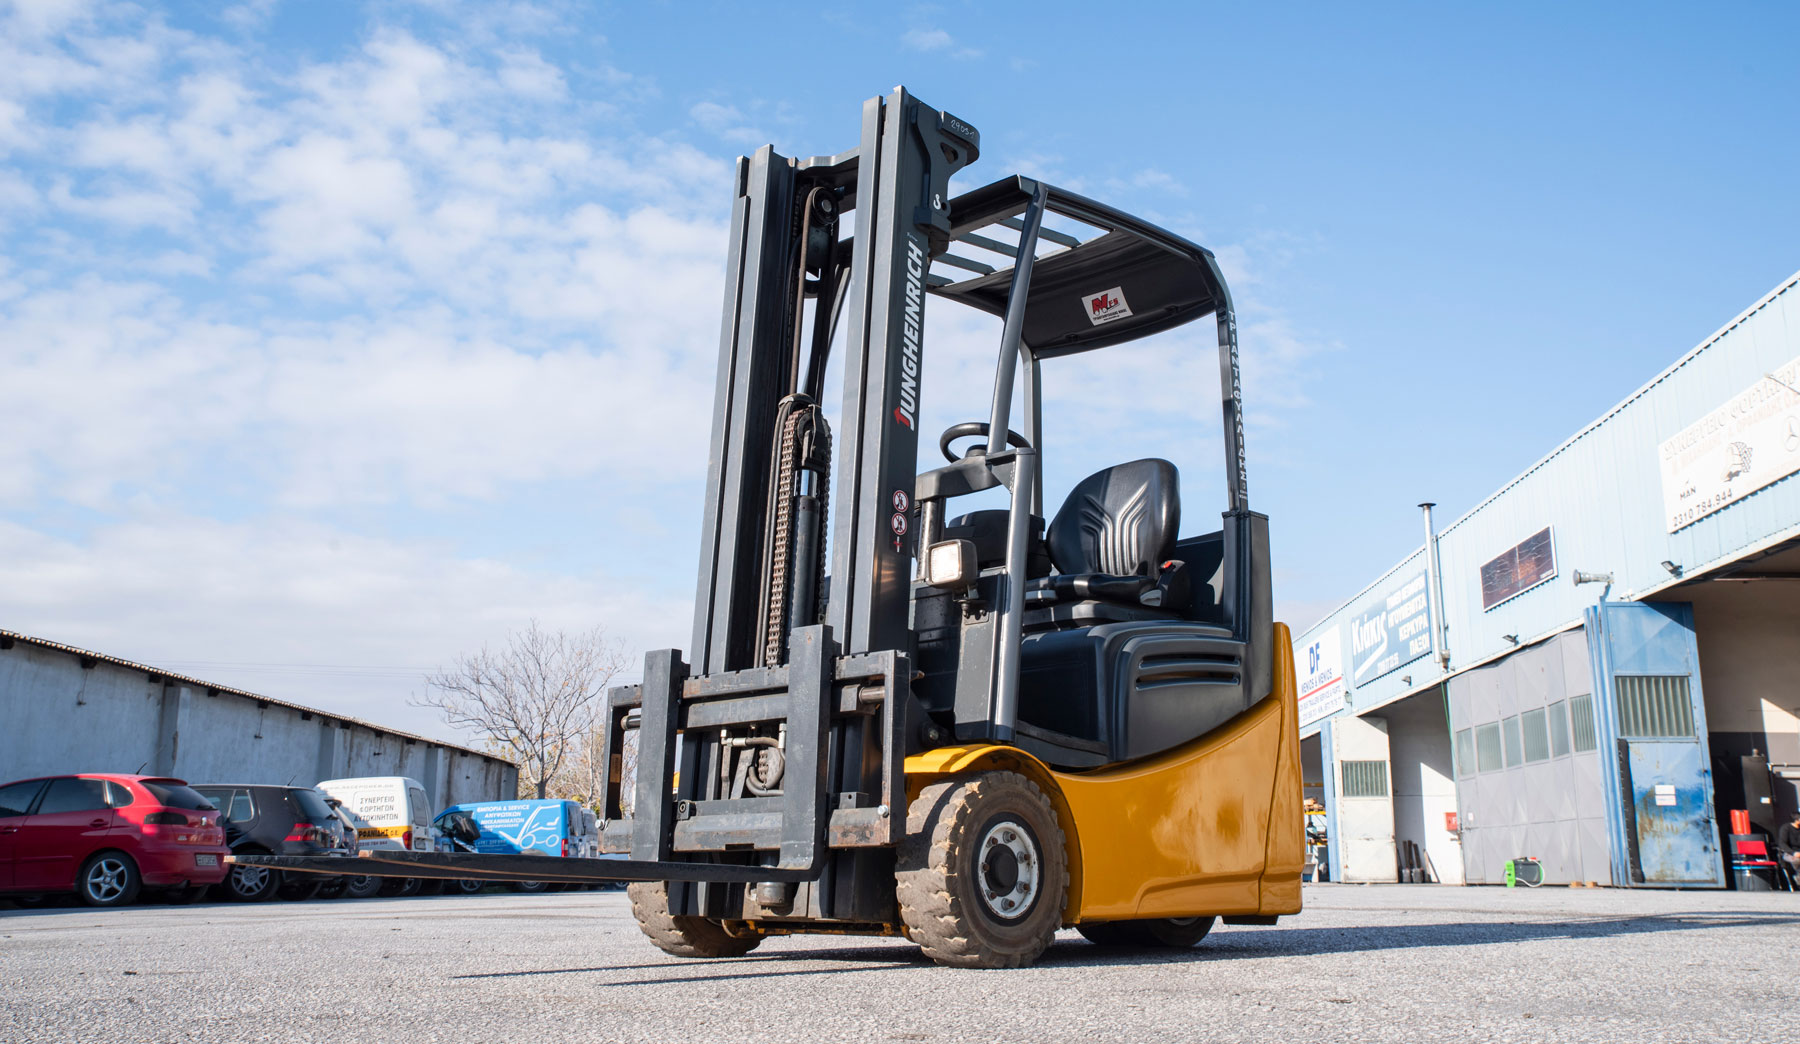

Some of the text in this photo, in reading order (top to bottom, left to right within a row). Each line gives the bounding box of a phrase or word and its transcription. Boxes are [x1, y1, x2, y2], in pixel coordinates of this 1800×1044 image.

[895, 241, 922, 431] JUNGHEINRICH
[1672, 487, 1733, 527] 2310 784.944
[1679, 486, 1696, 501] MAN
[1309, 642, 1320, 675] DF
[360, 796, 395, 804] ΣΥΝΕΡΓΕΙΟ
